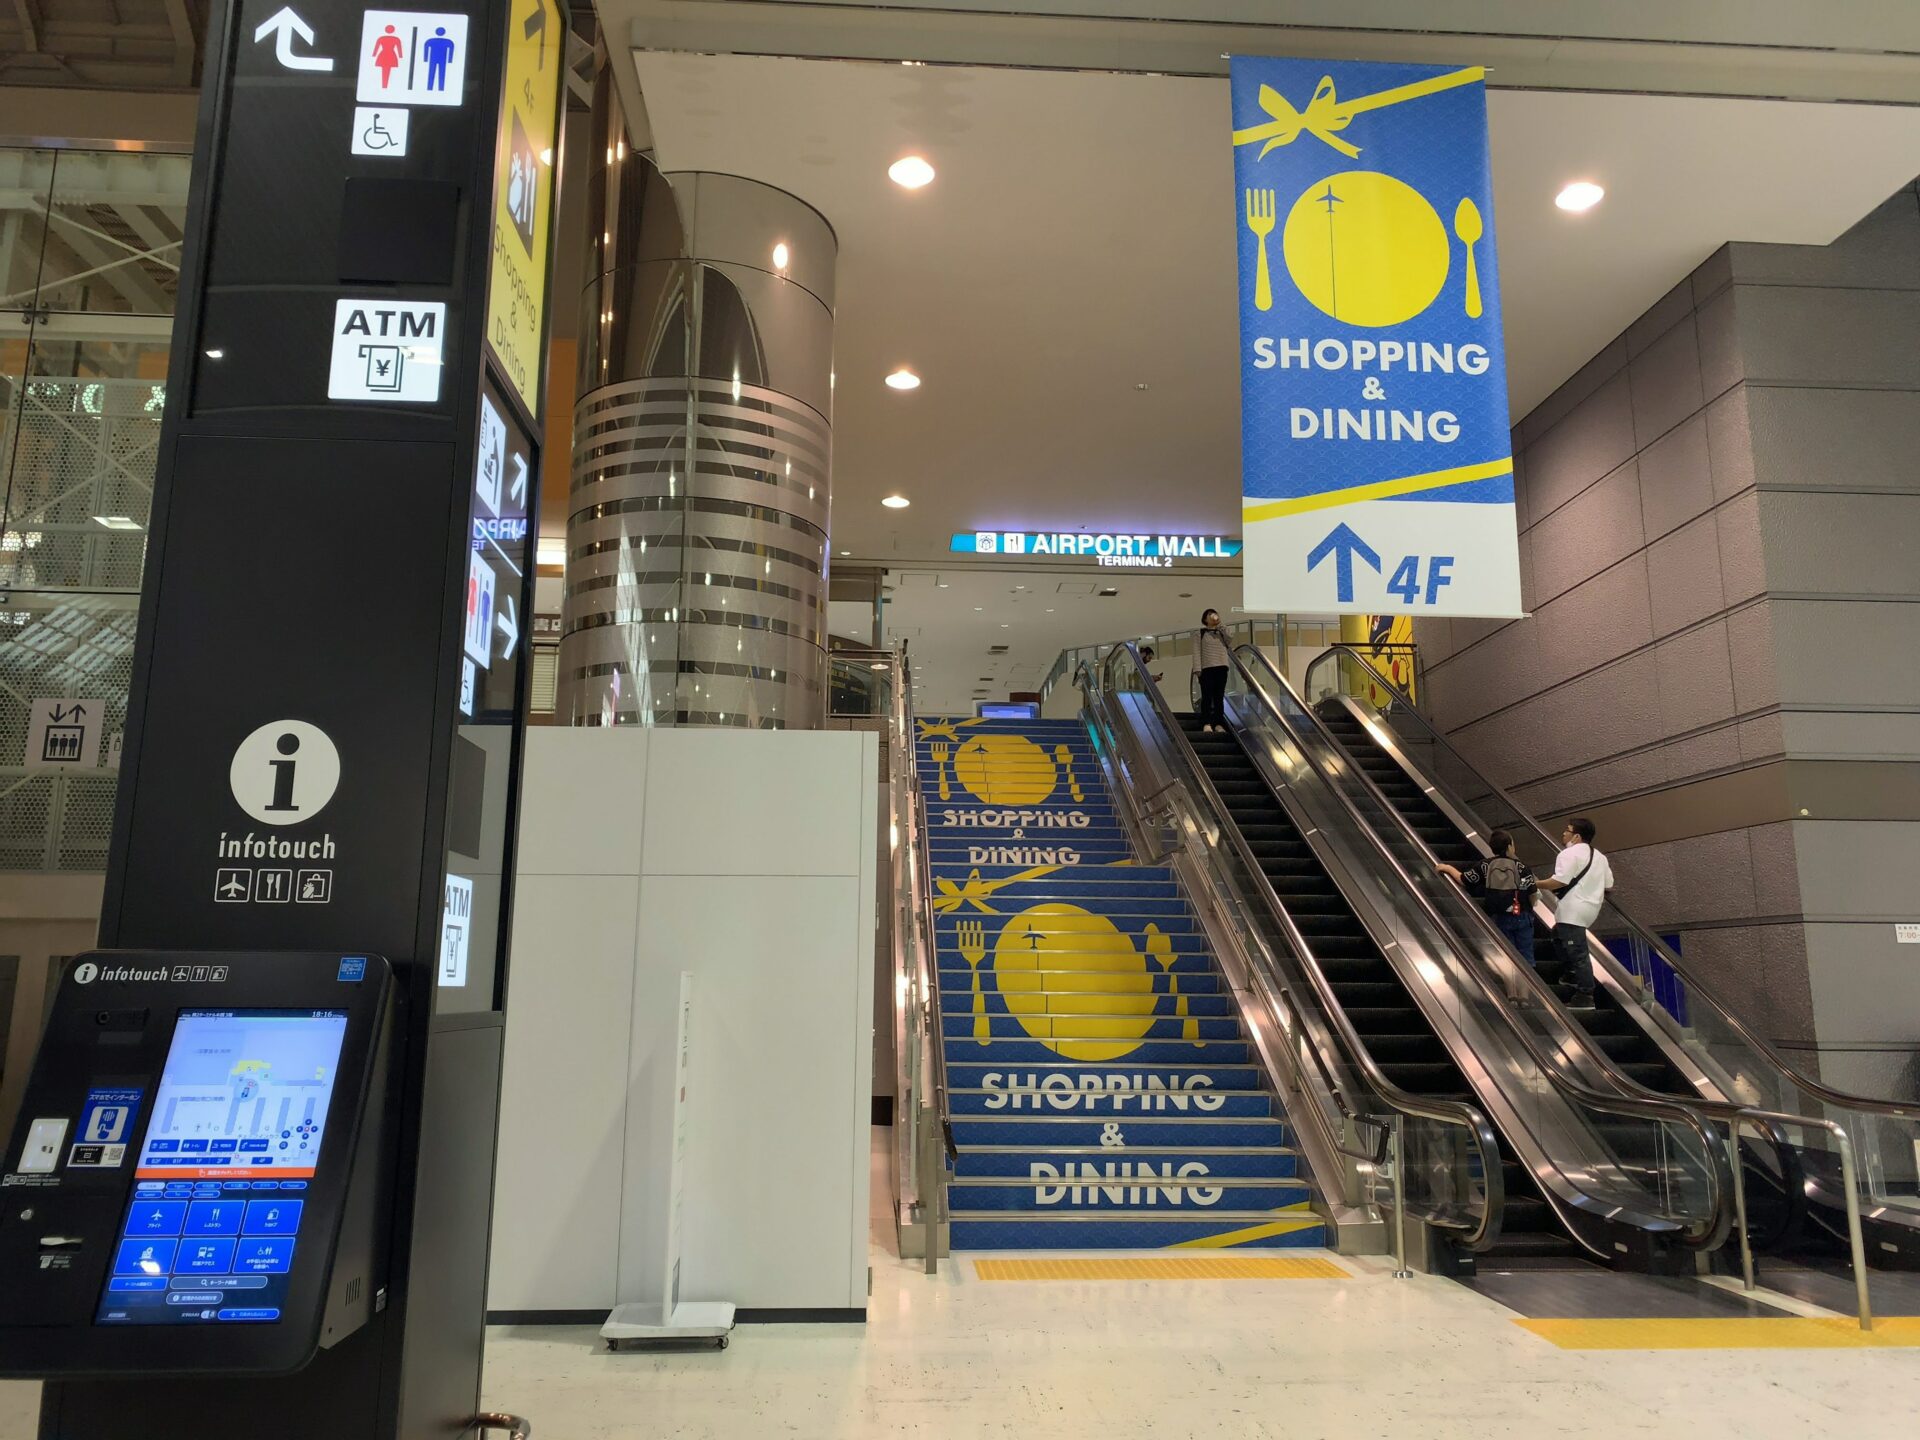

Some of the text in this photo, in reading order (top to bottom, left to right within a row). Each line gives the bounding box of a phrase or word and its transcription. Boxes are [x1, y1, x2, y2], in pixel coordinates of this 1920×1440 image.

[494, 224, 537, 332] Shopping
[341, 309, 436, 338] ATM
[510, 301, 518, 332] &
[495, 315, 526, 394] Dining
[1253, 337, 1490, 375] SHOPPING
[1361, 376, 1387, 401] &
[1290, 407, 1461, 442] DINING
[1031, 533, 1231, 557] AIRPORT MALL
[1096, 555, 1173, 568] TERMINAL 2
[1386, 555, 1455, 605] 4F
[942, 809, 1091, 828] SHOPPING
[218, 832, 336, 859] infotouch
[1012, 828, 1027, 839] &
[968, 846, 1081, 865] DINING
[444, 884, 470, 918] ATM
[100, 966, 168, 981] infotouch
[981, 1072, 1226, 1111] SHOPPING
[1099, 1121, 1126, 1150] &
[1030, 1162, 1224, 1206] DINING
